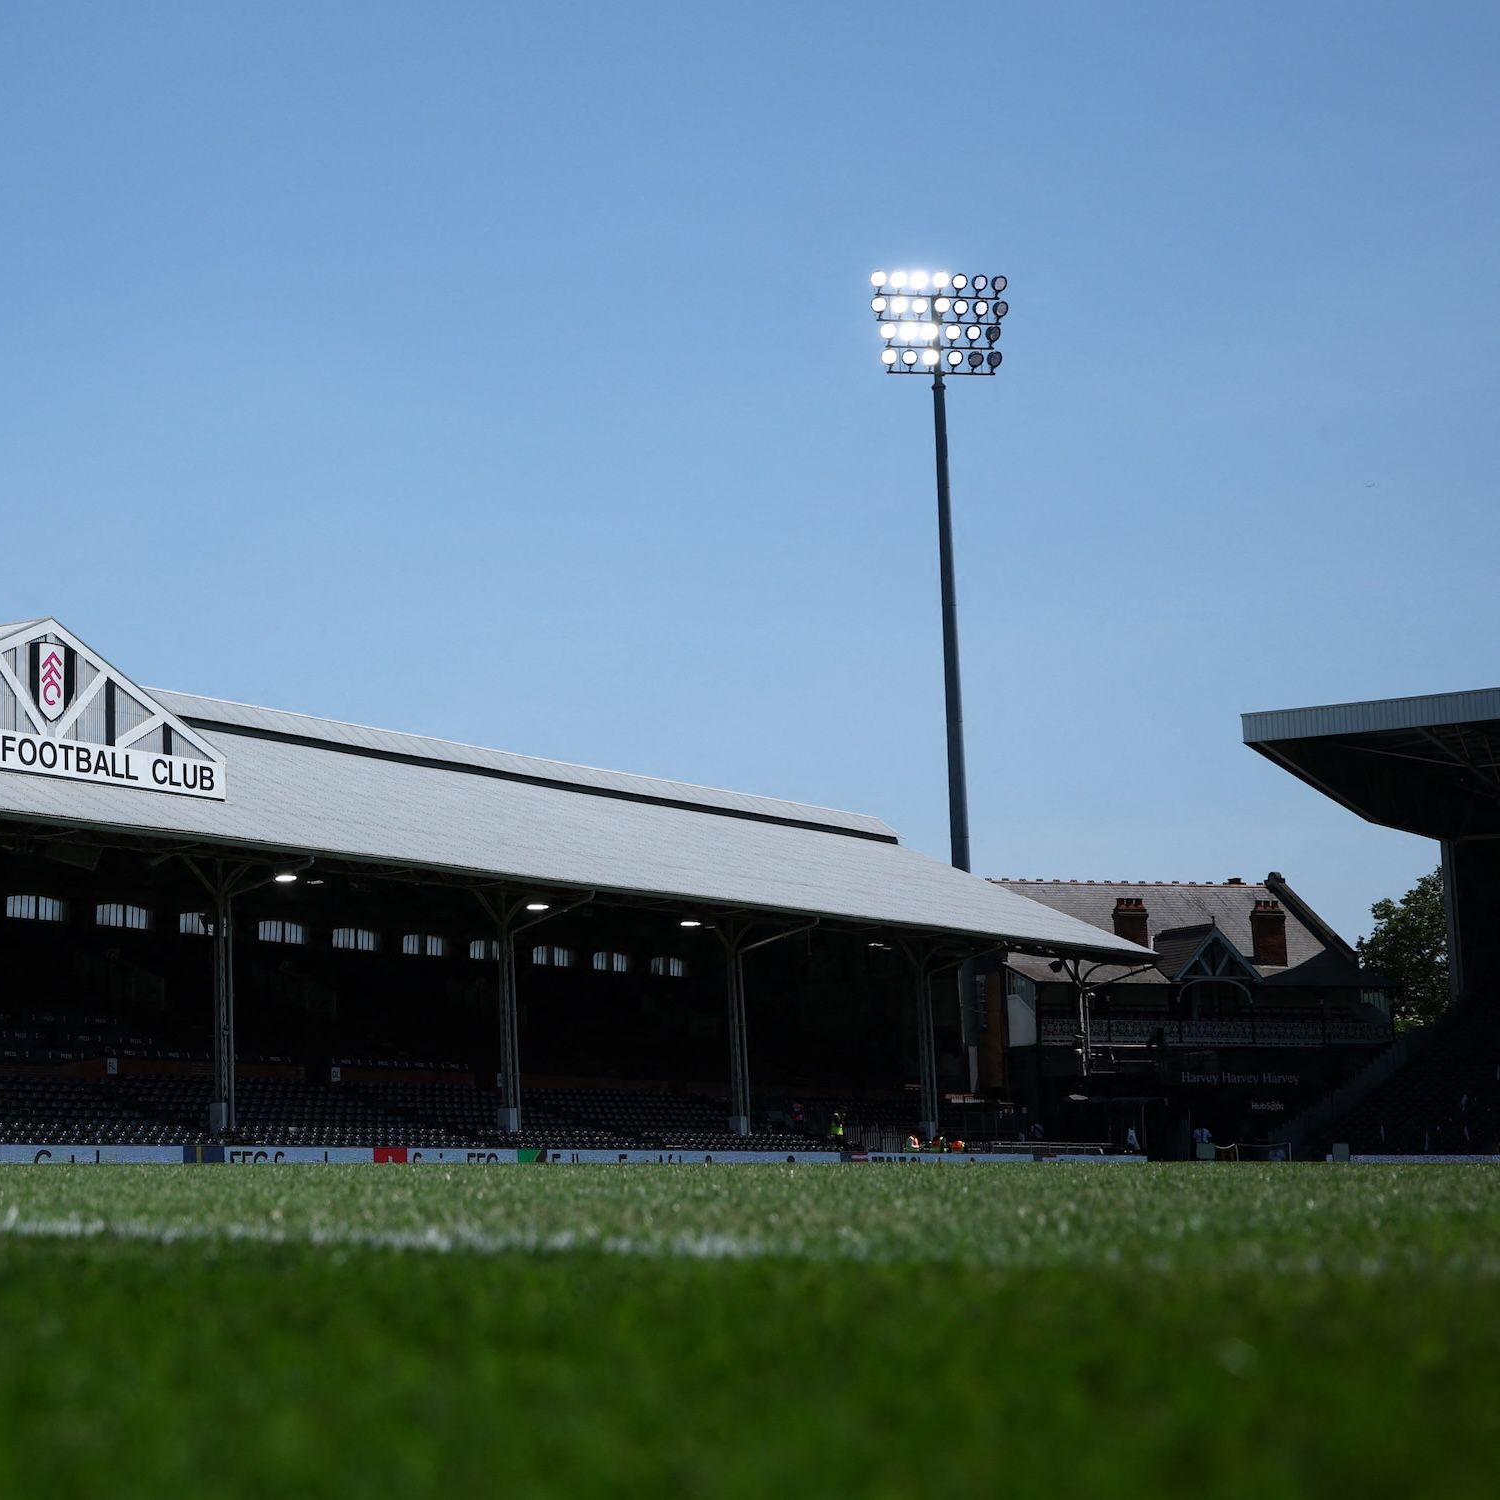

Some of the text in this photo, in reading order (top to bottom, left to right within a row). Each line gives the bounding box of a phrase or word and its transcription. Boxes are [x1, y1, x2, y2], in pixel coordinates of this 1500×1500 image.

[41, 651, 62, 706] FFC
[1, 734, 139, 781] FOOTBALL
[151, 757, 215, 791] CLUB
[1180, 1071, 1300, 1086] Harvey Harvey Harvey
[1251, 1099, 1285, 1113] HubSpot
